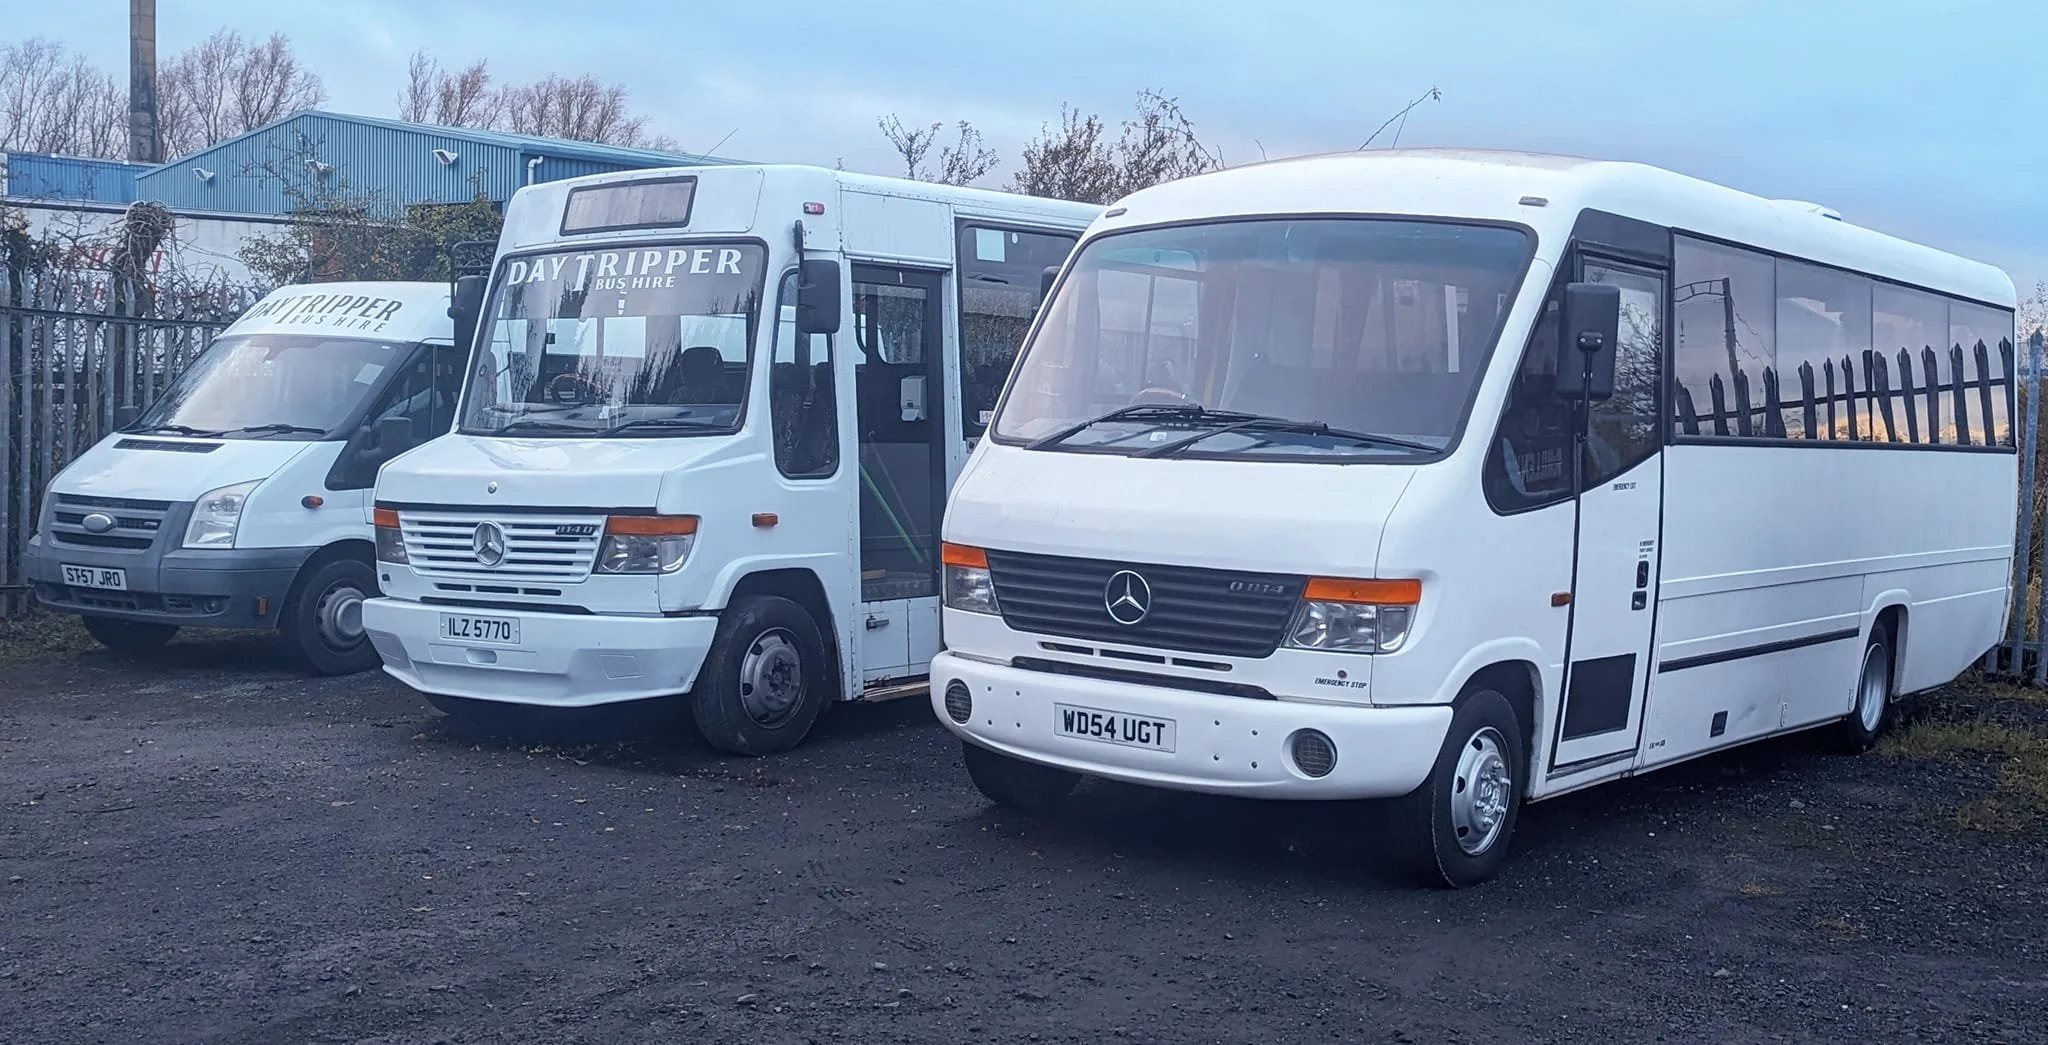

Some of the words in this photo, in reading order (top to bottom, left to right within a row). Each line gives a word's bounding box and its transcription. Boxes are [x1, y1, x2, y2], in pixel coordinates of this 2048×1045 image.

[507, 255, 569, 286] DAY
[572, 248, 742, 292] TRIPPER
[595, 276, 627, 291] BUS
[632, 275, 677, 289] HIRE
[243, 296, 297, 321] DAY
[274, 294, 404, 325] TRIPPER
[288, 314, 328, 325] BUS
[332, 316, 387, 333] HIRE
[66, 566, 94, 585] ST57
[448, 617, 470, 637] ILZ
[474, 619, 511, 640] 5770
[1314, 677, 1350, 688] EMERGENCY
[1350, 681, 1368, 689] STOP
[1063, 708, 1117, 739] WD54
[1122, 718, 1166, 746] UGT
